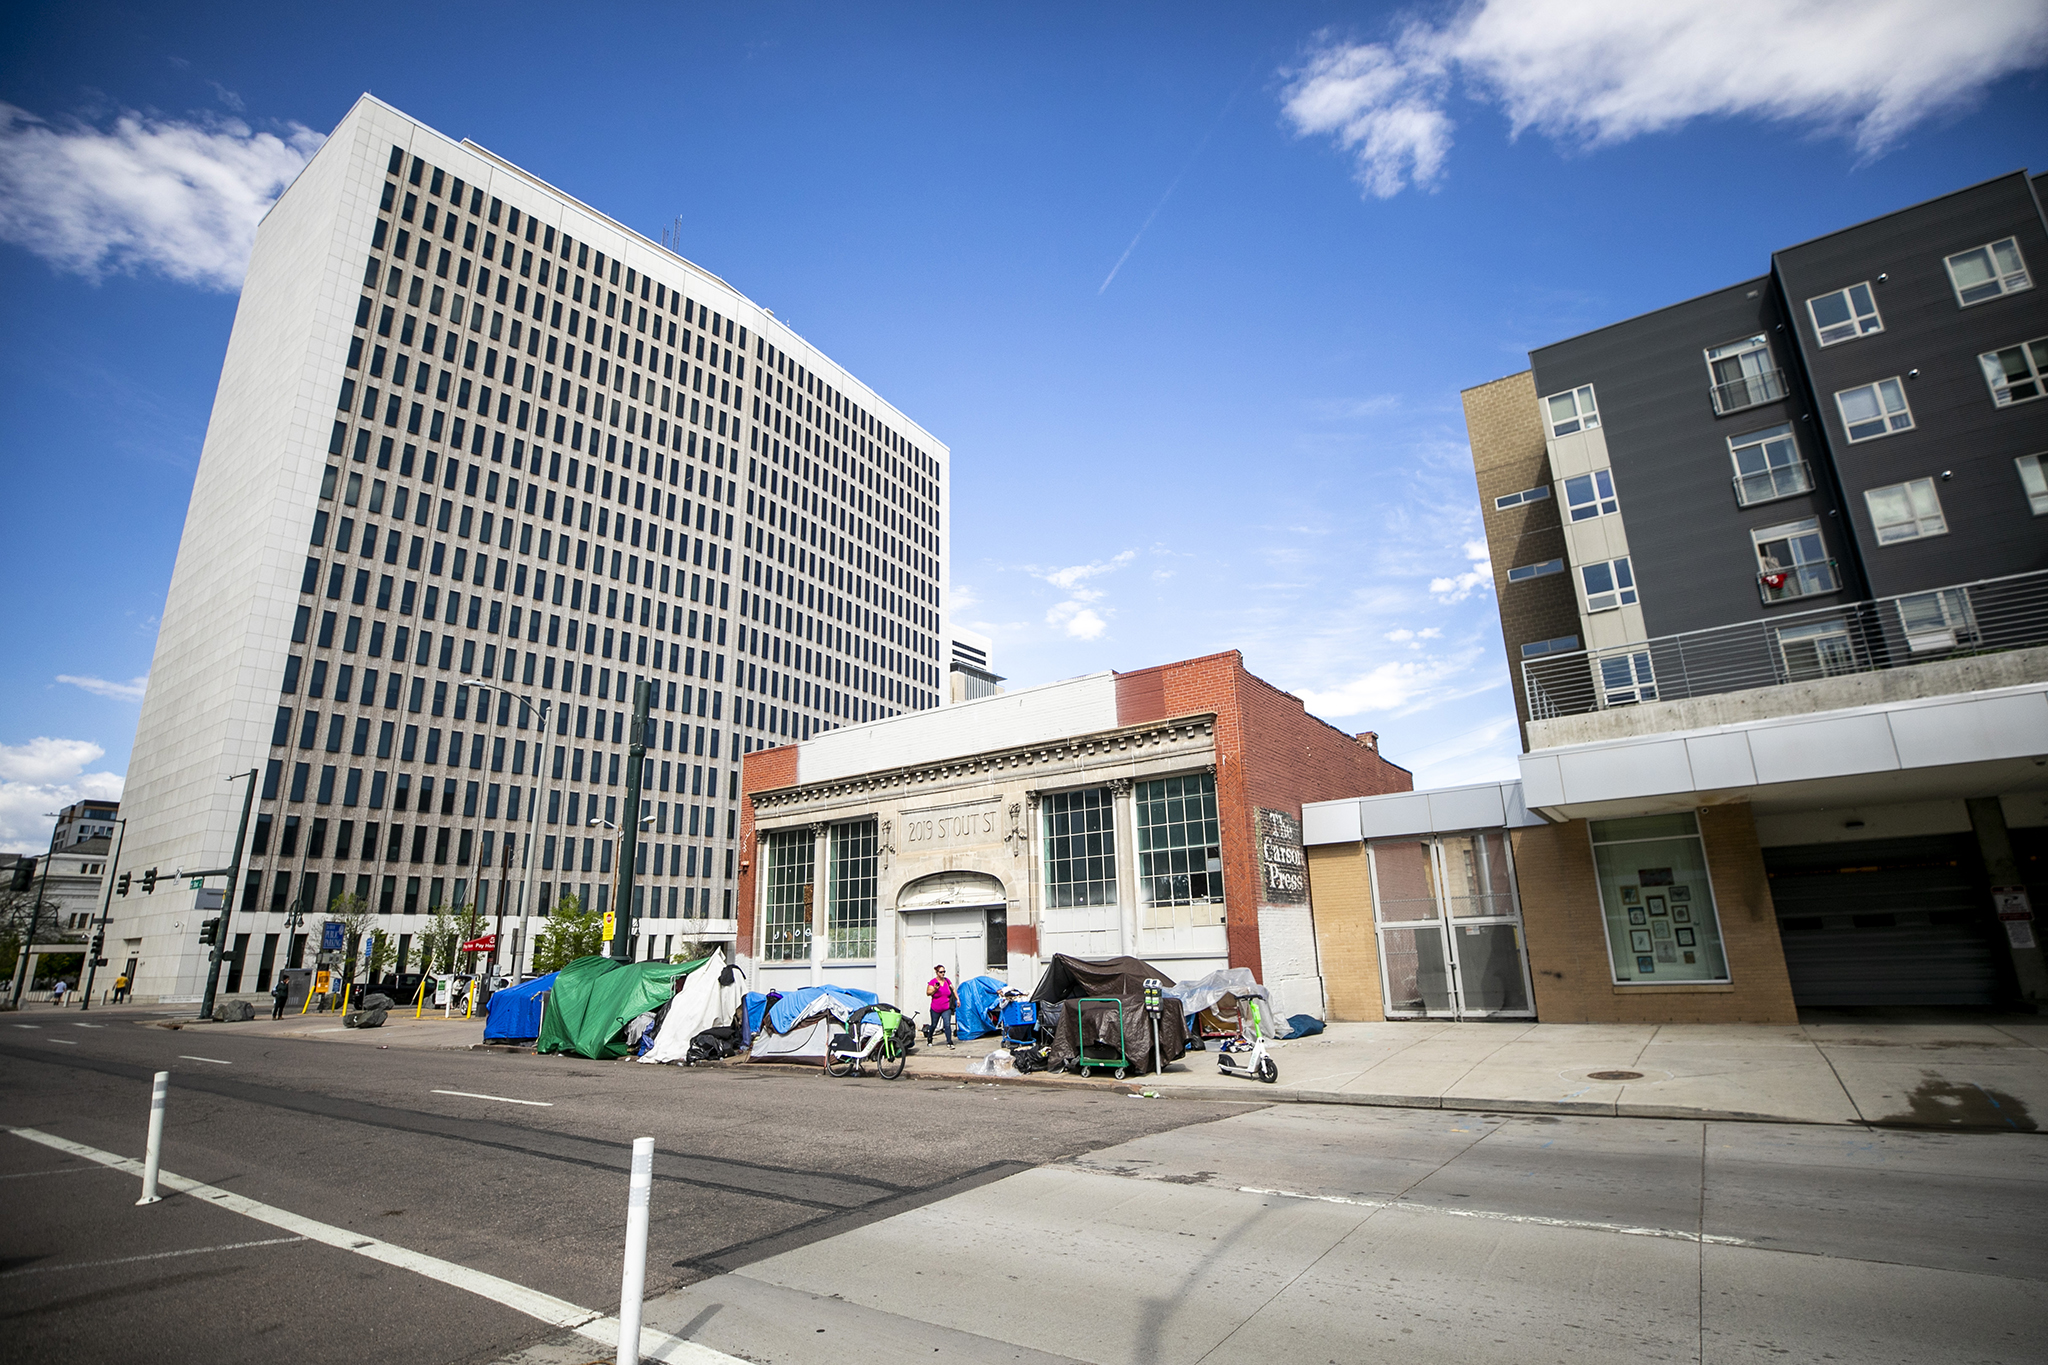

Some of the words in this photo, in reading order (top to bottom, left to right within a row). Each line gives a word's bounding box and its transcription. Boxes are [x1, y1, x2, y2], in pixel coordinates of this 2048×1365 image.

[908, 820, 933, 842] 2019
[938, 813, 980, 839] STOUT
[982, 811, 997, 833] ST
[1263, 837, 1306, 867] Carson
[1265, 862, 1303, 890] Press
